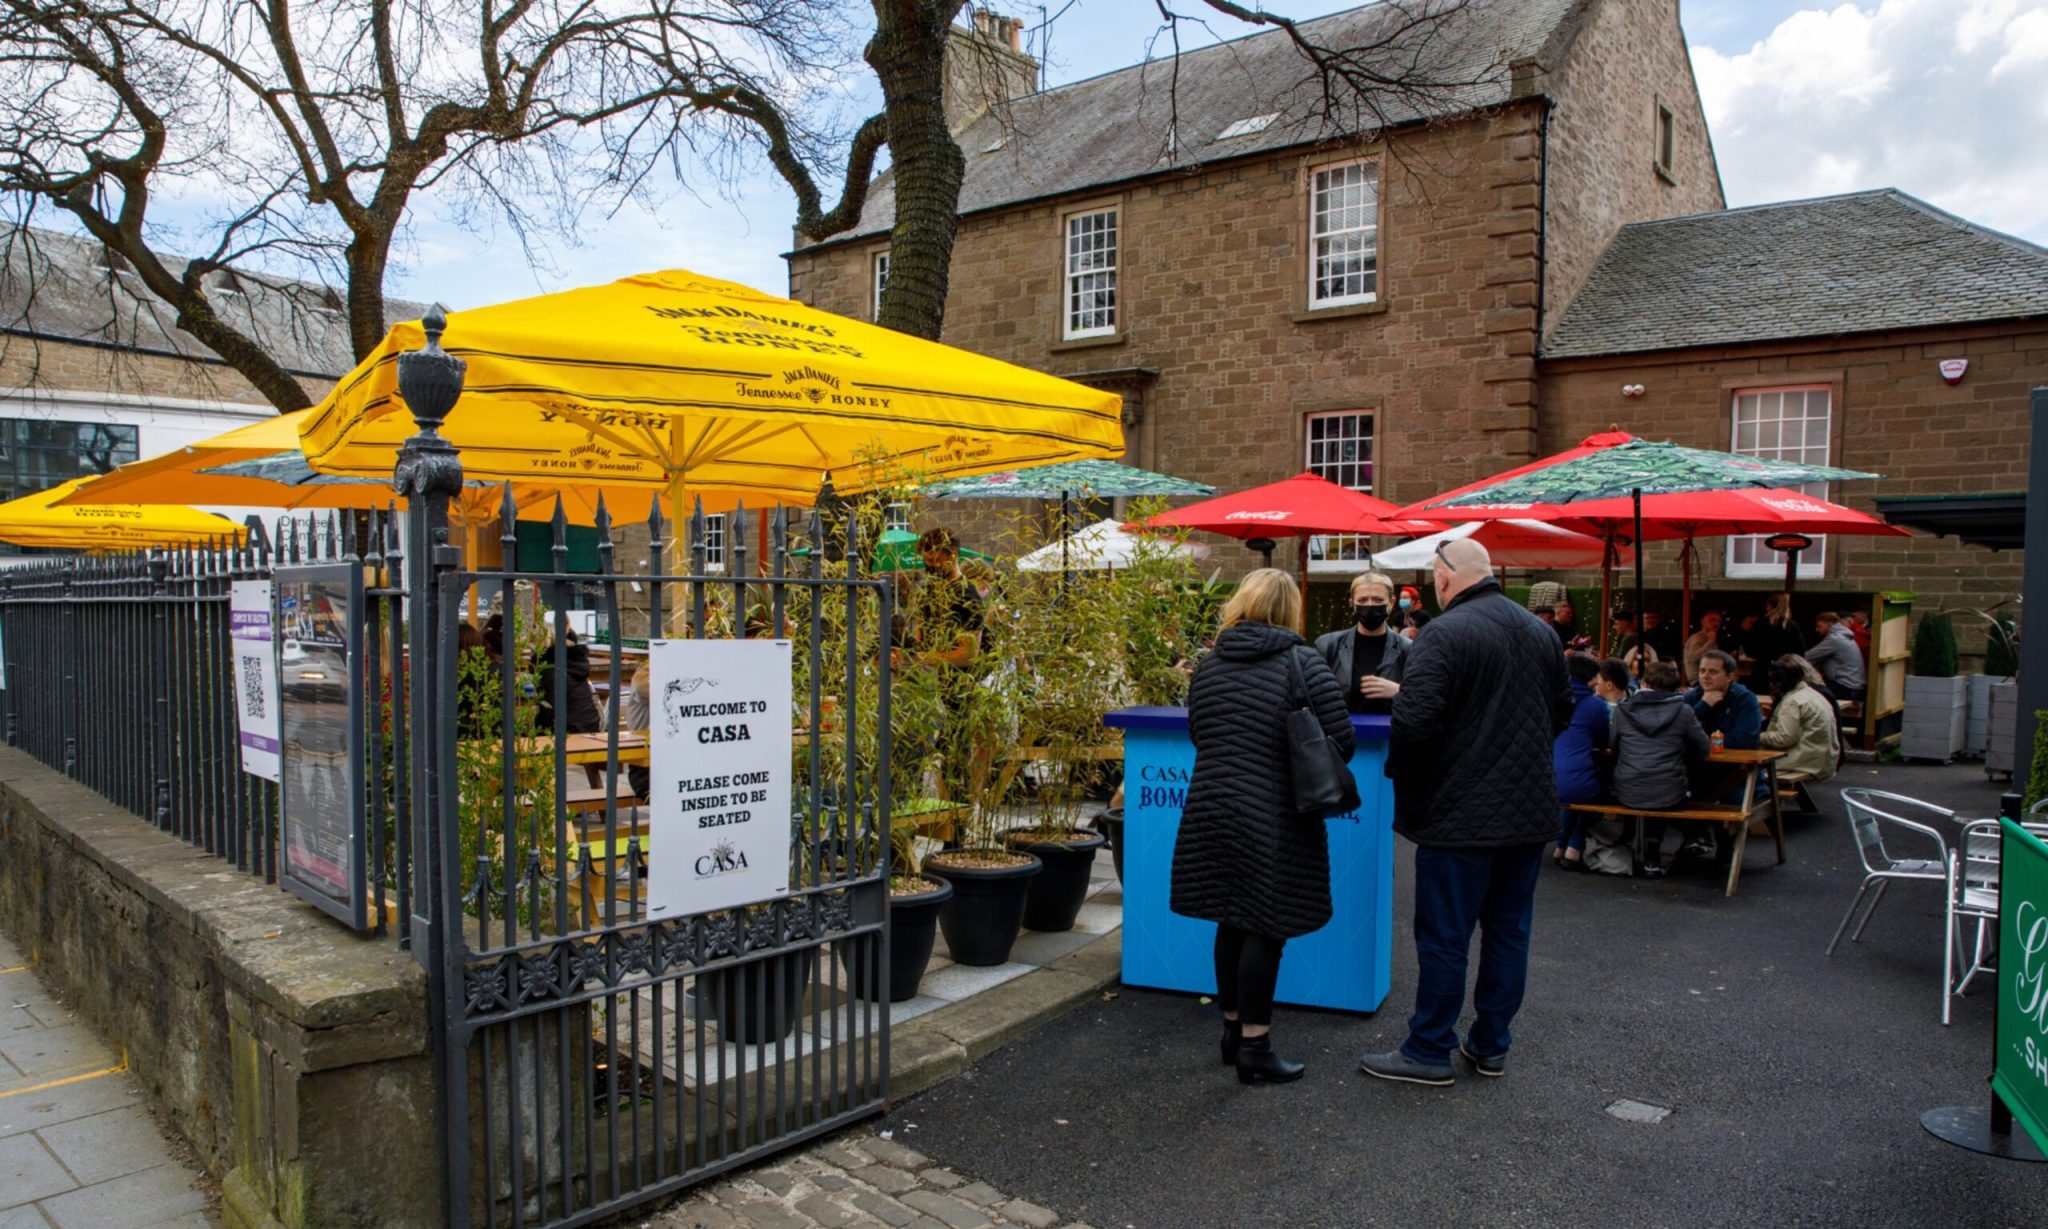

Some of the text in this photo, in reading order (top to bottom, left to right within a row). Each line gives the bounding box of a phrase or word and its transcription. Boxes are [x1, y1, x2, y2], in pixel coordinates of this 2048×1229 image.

[782, 366, 841, 390] JACK DANIEL'S
[736, 382, 891, 408] Tennessee HONEY
[679, 700, 767, 719] WELCOME TO
[697, 724, 751, 744] CASA
[678, 771, 770, 793] PLEASE COME
[1141, 765, 1189, 783] CASA
[681, 790, 767, 812] INSIDE TO BE
[1138, 786, 1186, 810] BOM
[698, 810, 751, 829] SEATED
[695, 850, 748, 876] CASA
